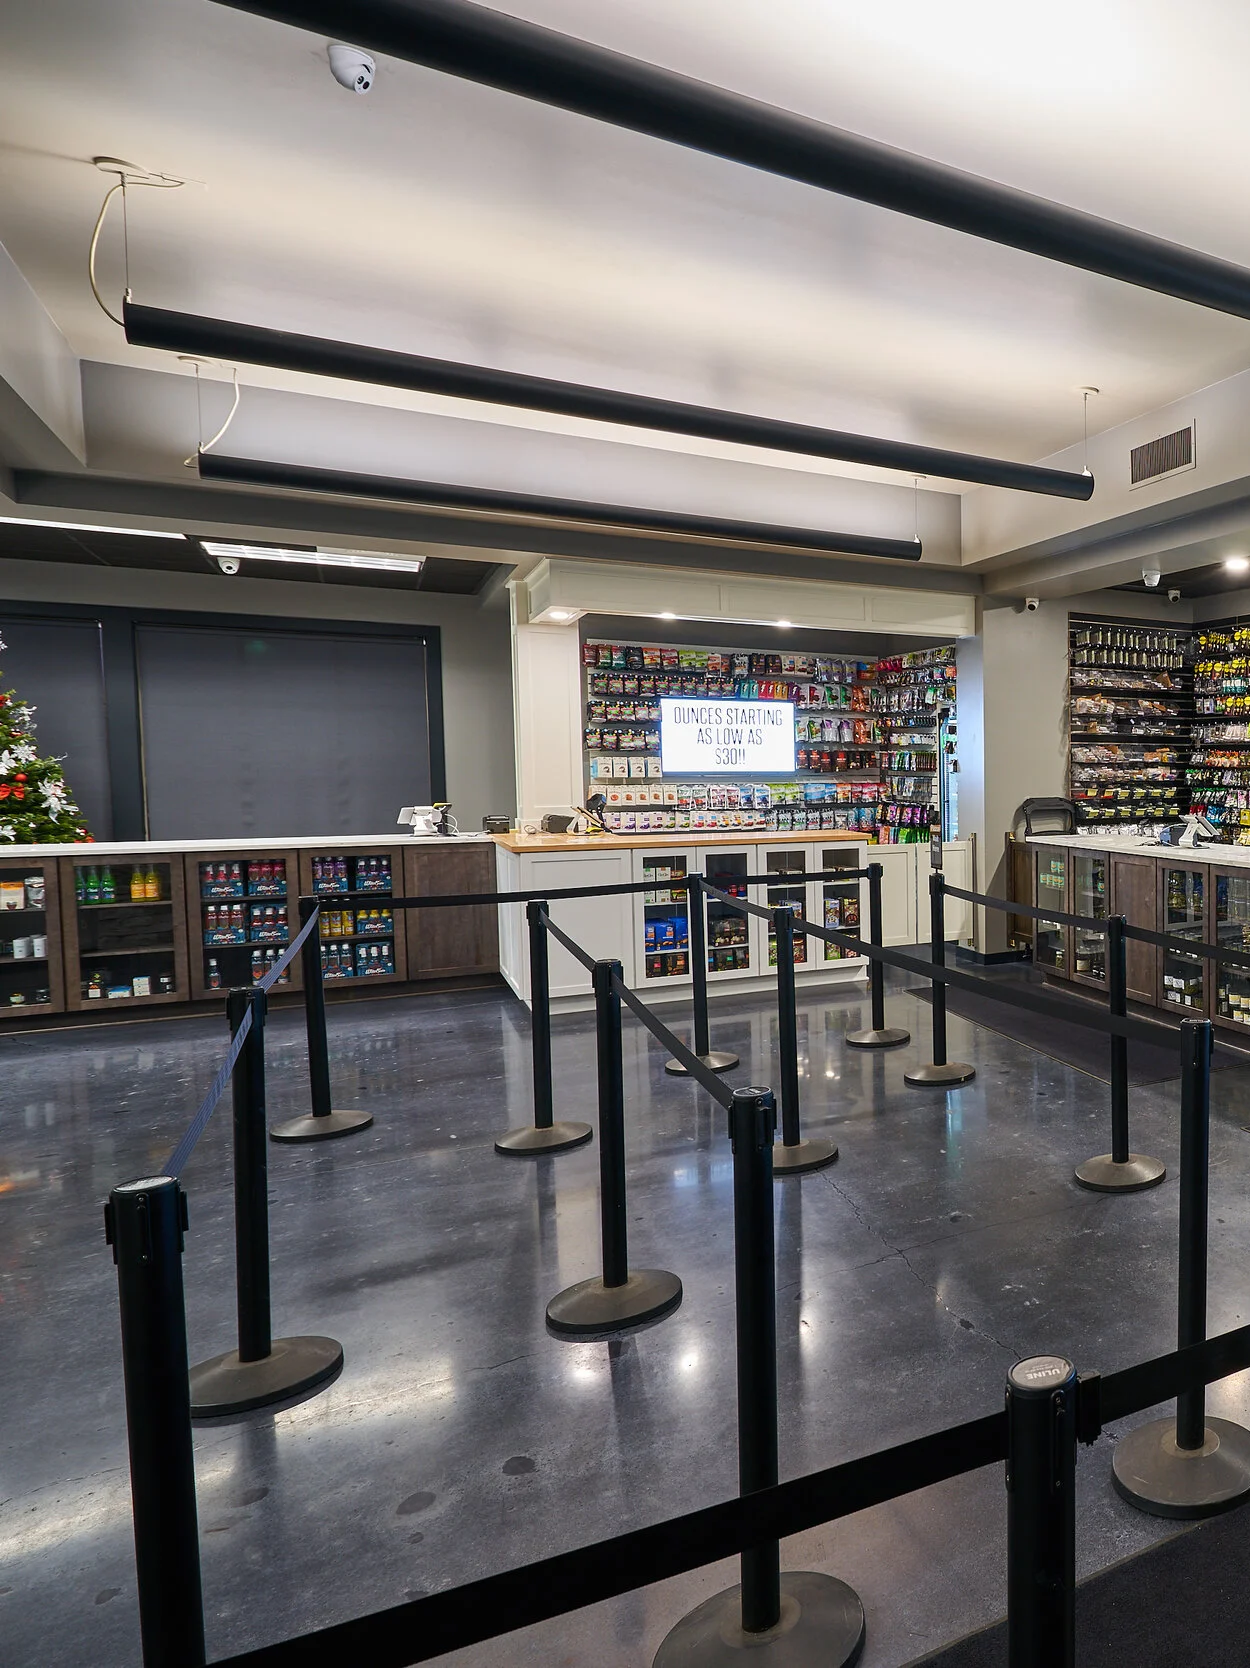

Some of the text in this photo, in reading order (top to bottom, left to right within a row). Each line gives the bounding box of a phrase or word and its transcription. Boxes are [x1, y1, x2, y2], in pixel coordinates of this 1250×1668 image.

[674, 706, 783, 726] OUNCES STARTING
[697, 728, 763, 745] AS LOW AS
[1026, 1367, 1061, 1380] ULINE
